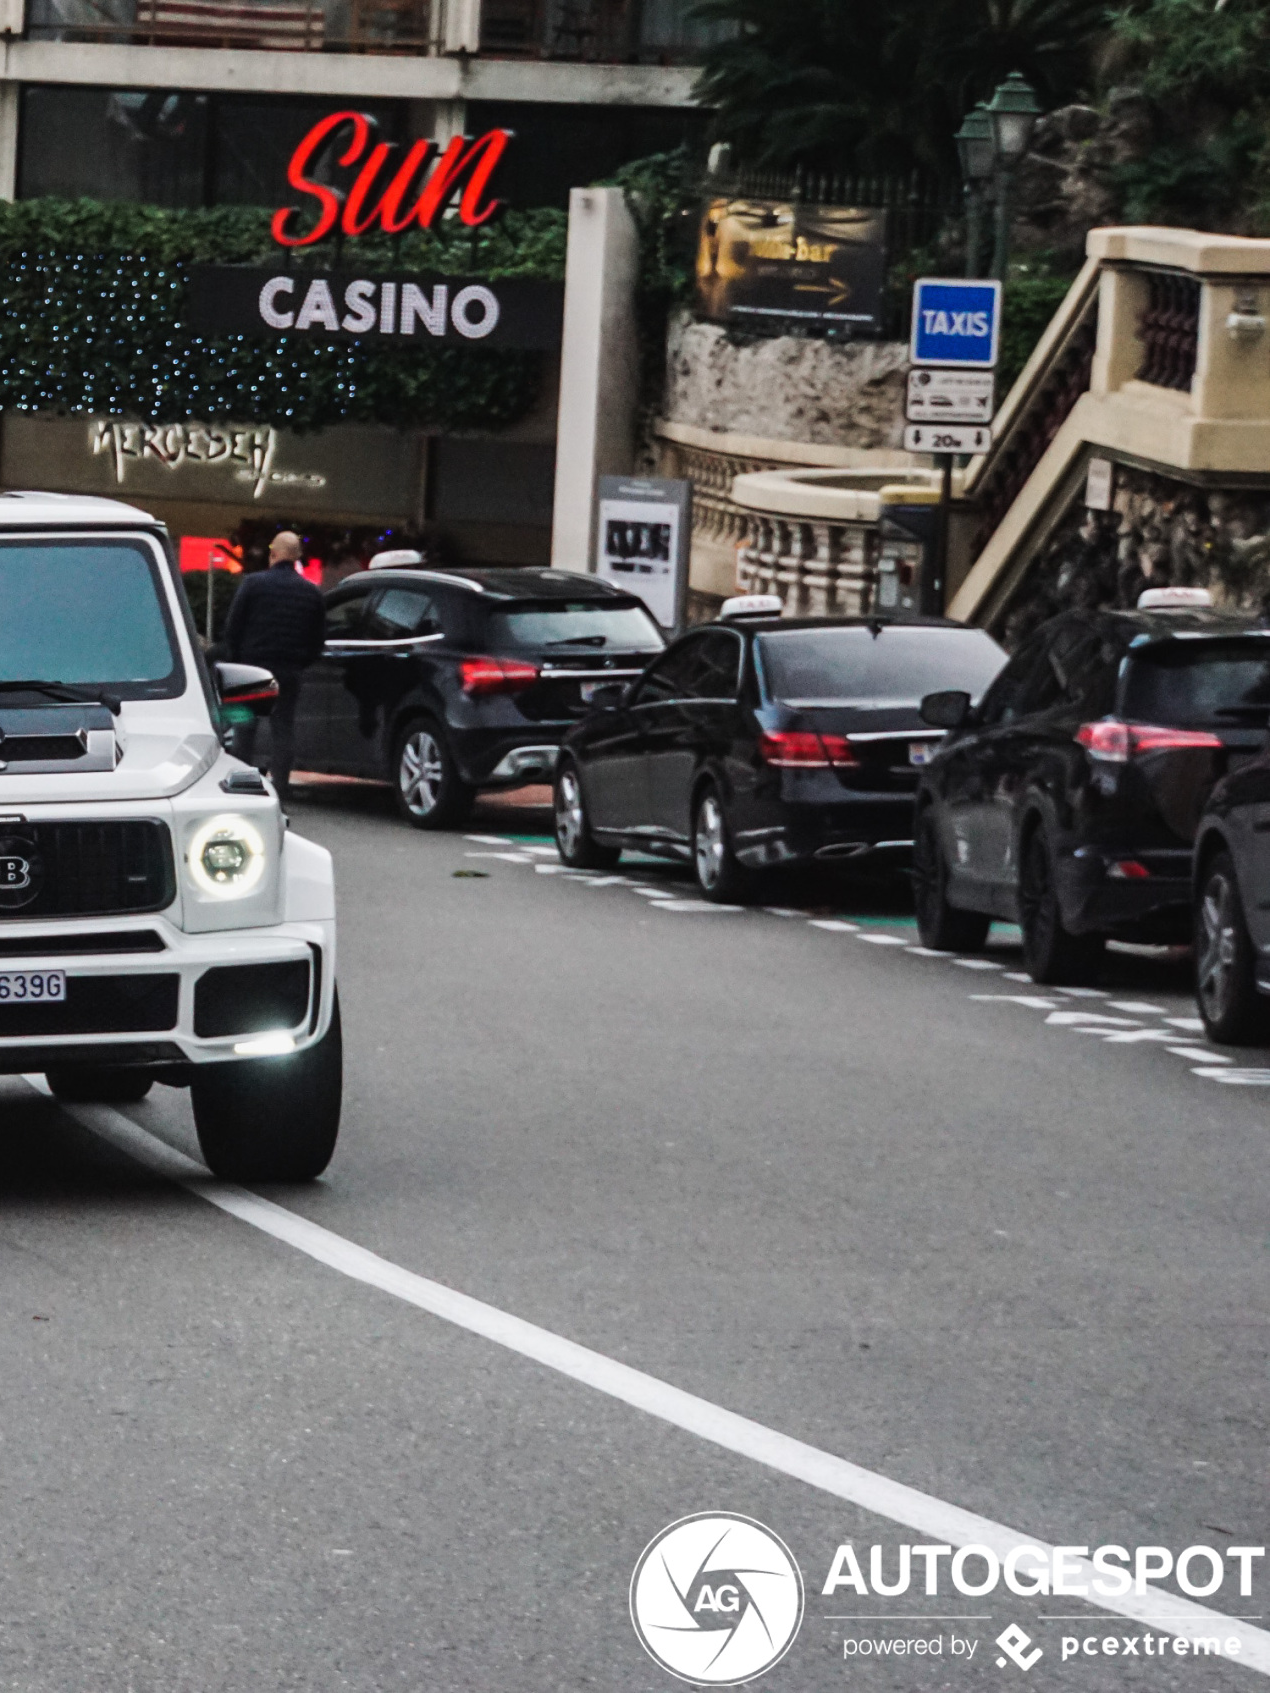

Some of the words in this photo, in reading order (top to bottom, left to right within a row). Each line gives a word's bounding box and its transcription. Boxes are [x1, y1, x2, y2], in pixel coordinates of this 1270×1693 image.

[271, 110, 509, 246] Sun
[258, 275, 500, 339] CASINO
[922, 309, 989, 337] TAXIS
